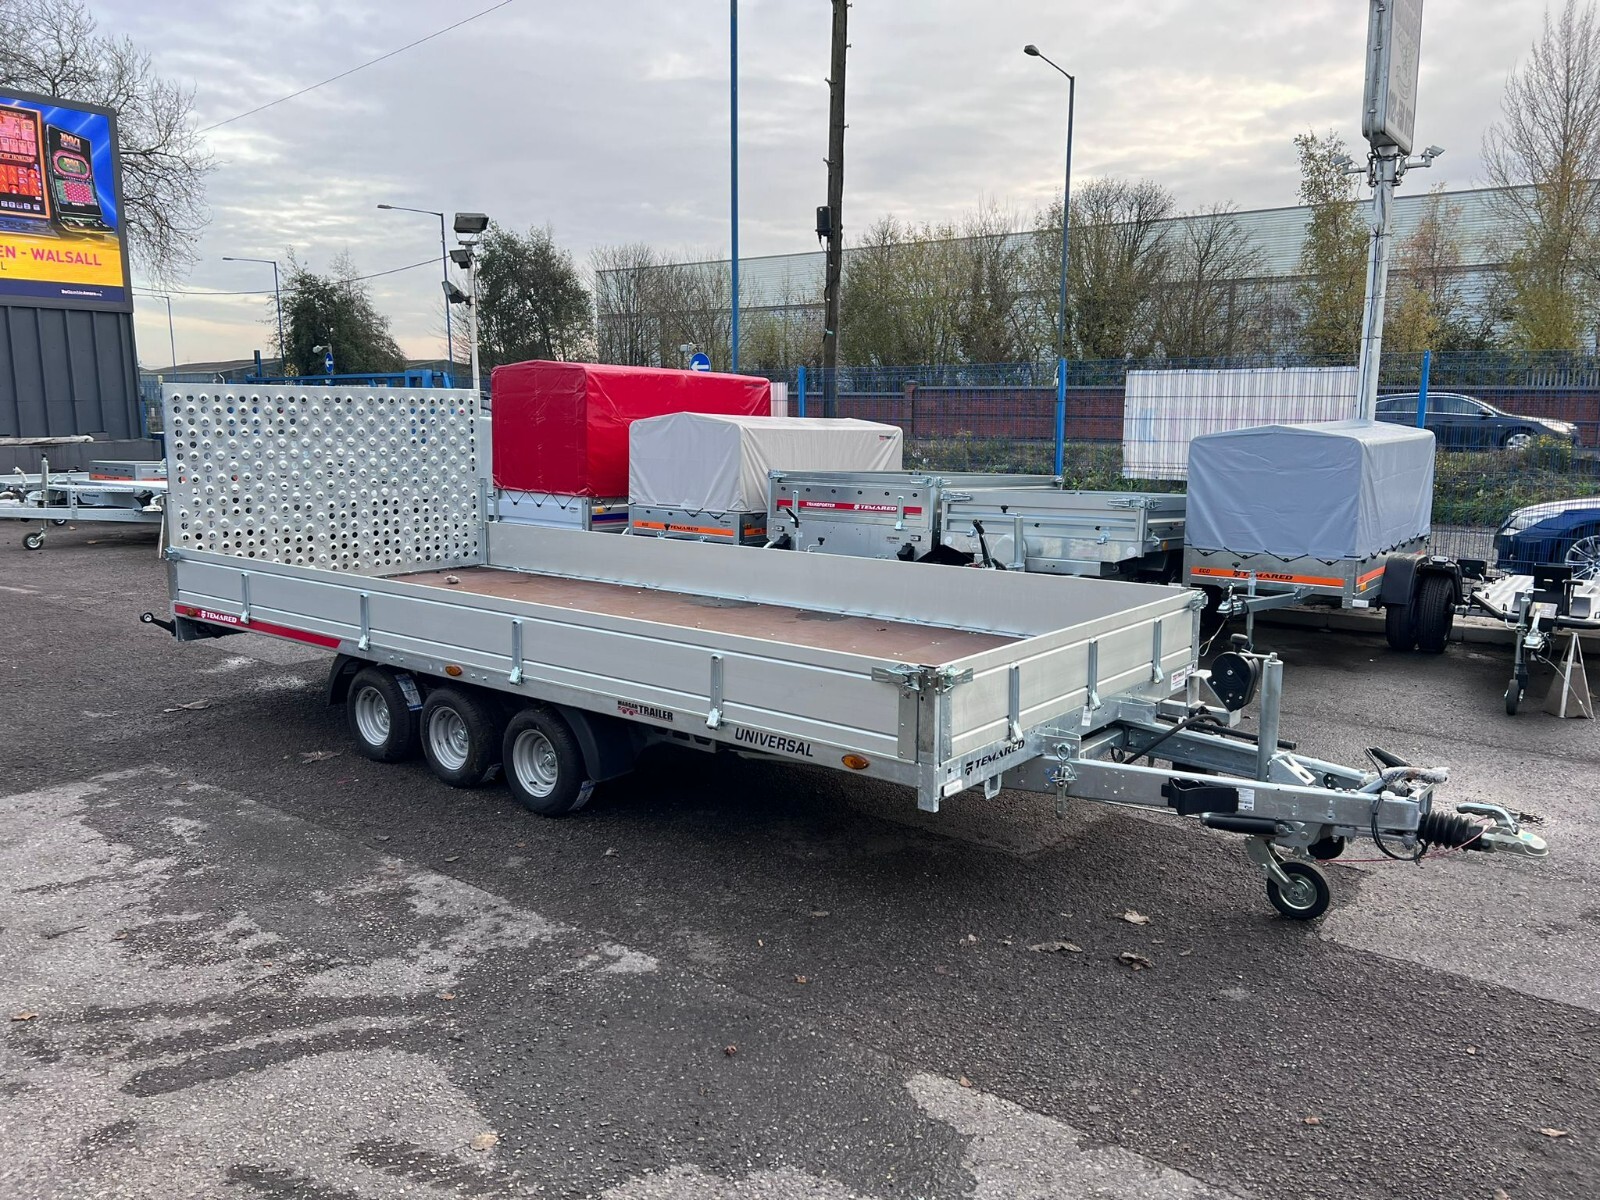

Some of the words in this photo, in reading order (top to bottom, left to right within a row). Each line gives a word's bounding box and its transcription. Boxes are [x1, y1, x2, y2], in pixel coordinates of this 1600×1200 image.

[30, 247, 102, 266] WALSALL
[1242, 571, 1294, 580] TMARED
[206, 611, 238, 624] TEMARED
[638, 705, 674, 721] TRAILER
[735, 727, 814, 757] UNIVERSAL
[974, 739, 1026, 769] TEMARED
